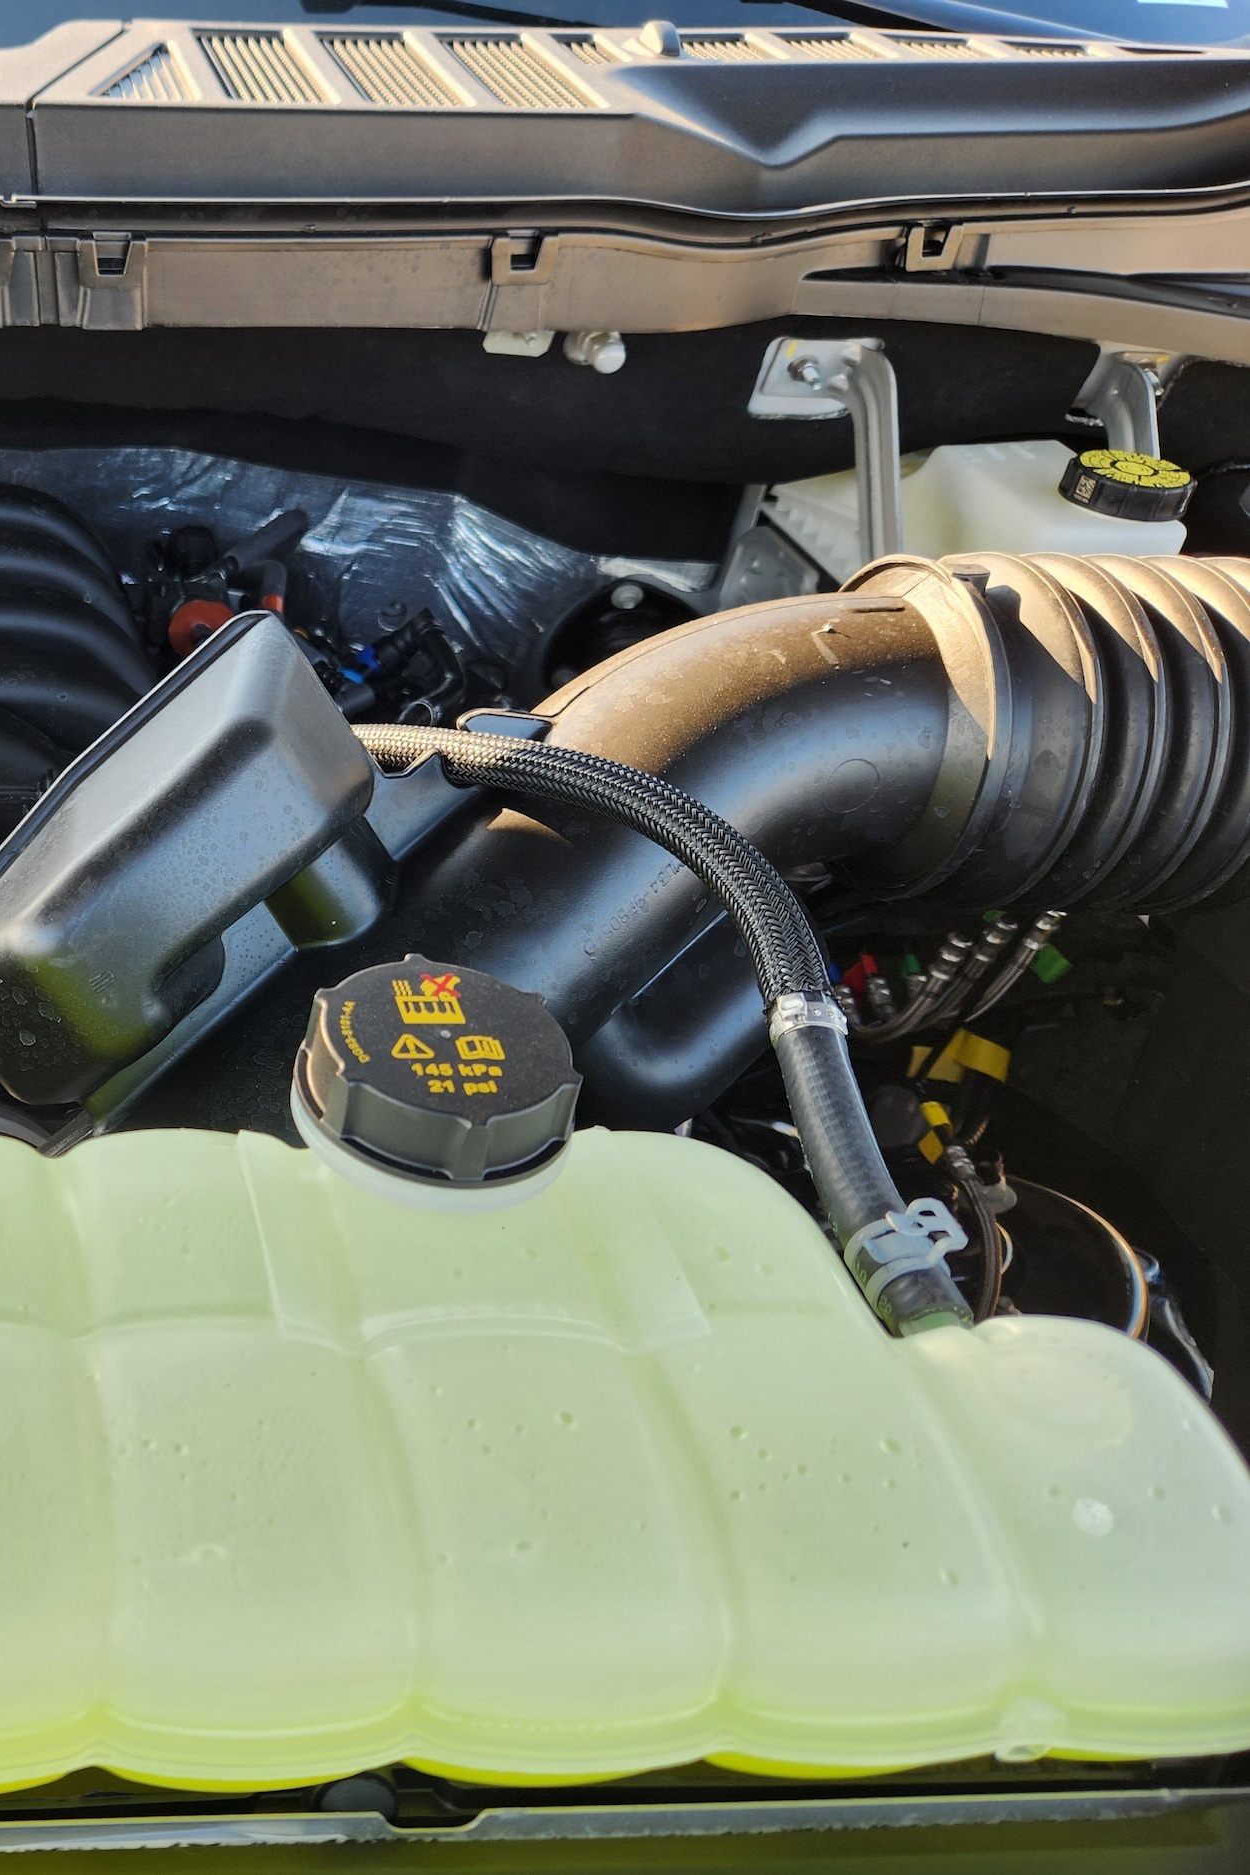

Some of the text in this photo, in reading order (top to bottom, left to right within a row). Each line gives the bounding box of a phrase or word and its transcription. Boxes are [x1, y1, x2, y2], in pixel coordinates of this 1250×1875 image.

[411, 1063, 503, 1077] 145 kPa
[427, 1079, 499, 1096] 21 psi
